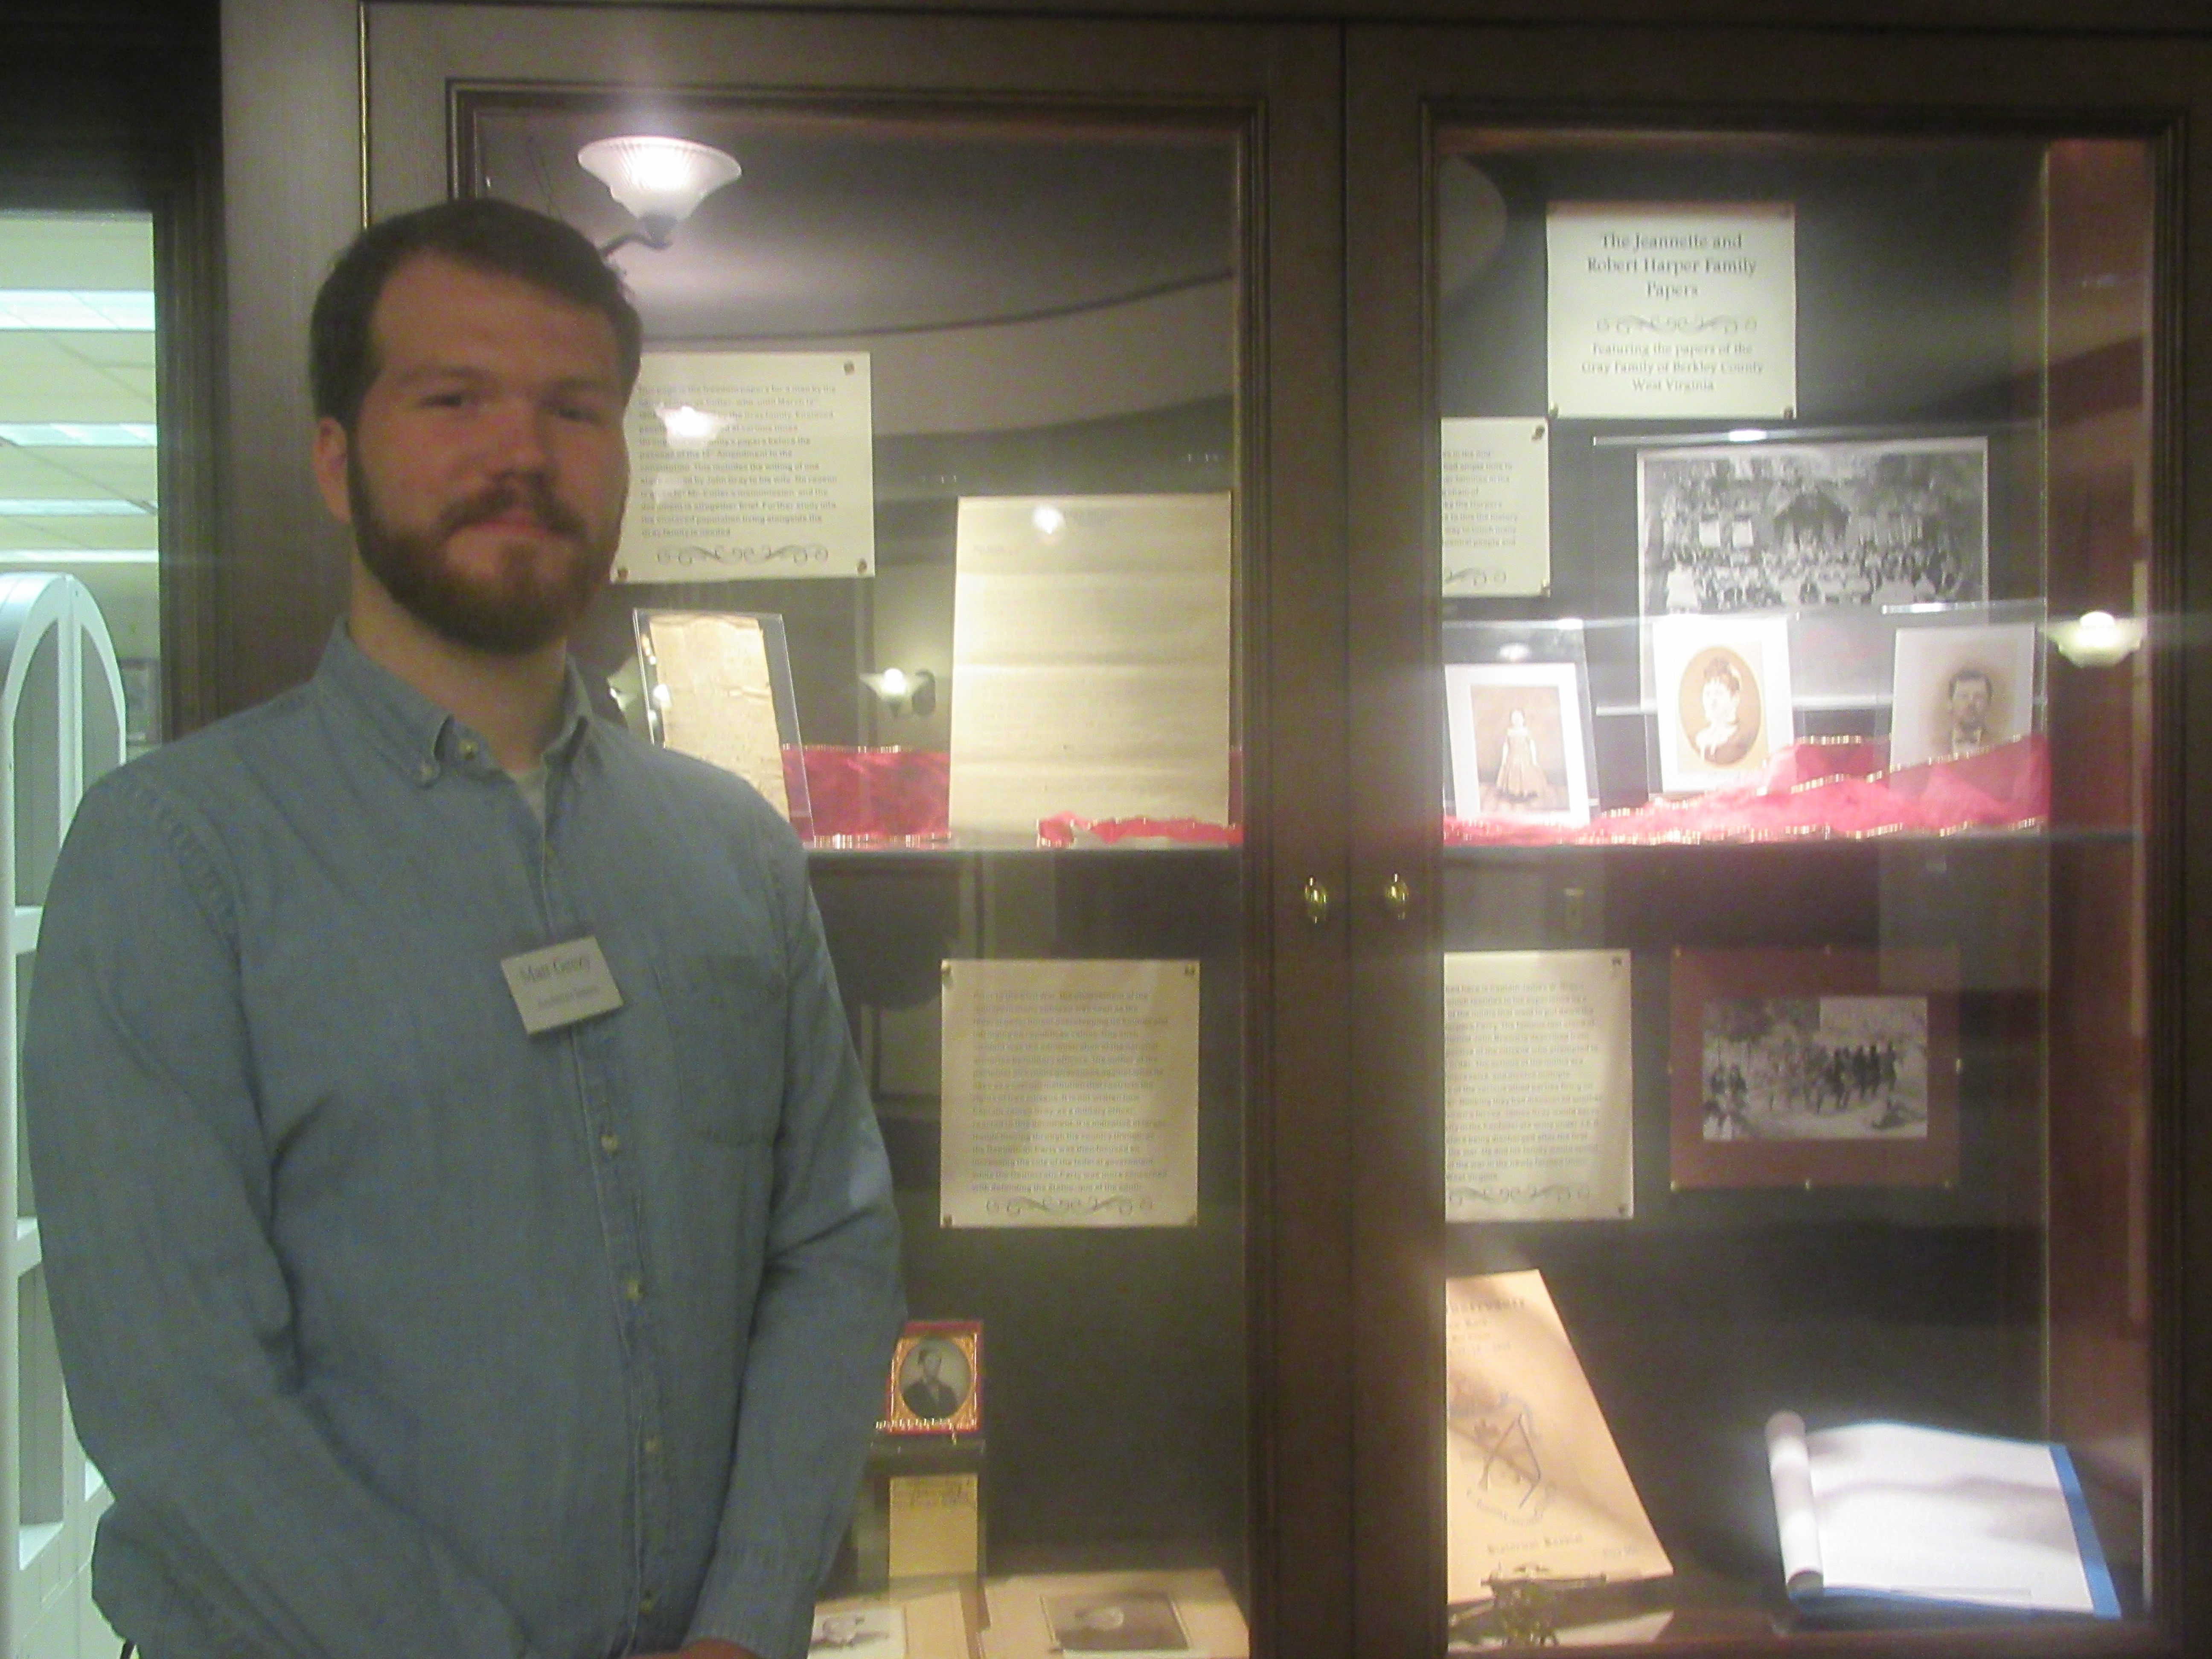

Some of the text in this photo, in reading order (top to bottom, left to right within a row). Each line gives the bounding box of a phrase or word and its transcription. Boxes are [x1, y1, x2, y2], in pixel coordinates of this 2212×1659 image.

[1601, 232, 1742, 253] The Jeannette and
[1587, 257, 1757, 279] Robert Harper Family
[1646, 280, 1698, 301] Papers
[1592, 341, 1753, 359] Featuring the papers of the
[1581, 361, 1610, 377] Gray
[1613, 361, 1654, 377] Family
[1657, 361, 1669, 375] of
[1632, 379, 1715, 395] West Virginia
